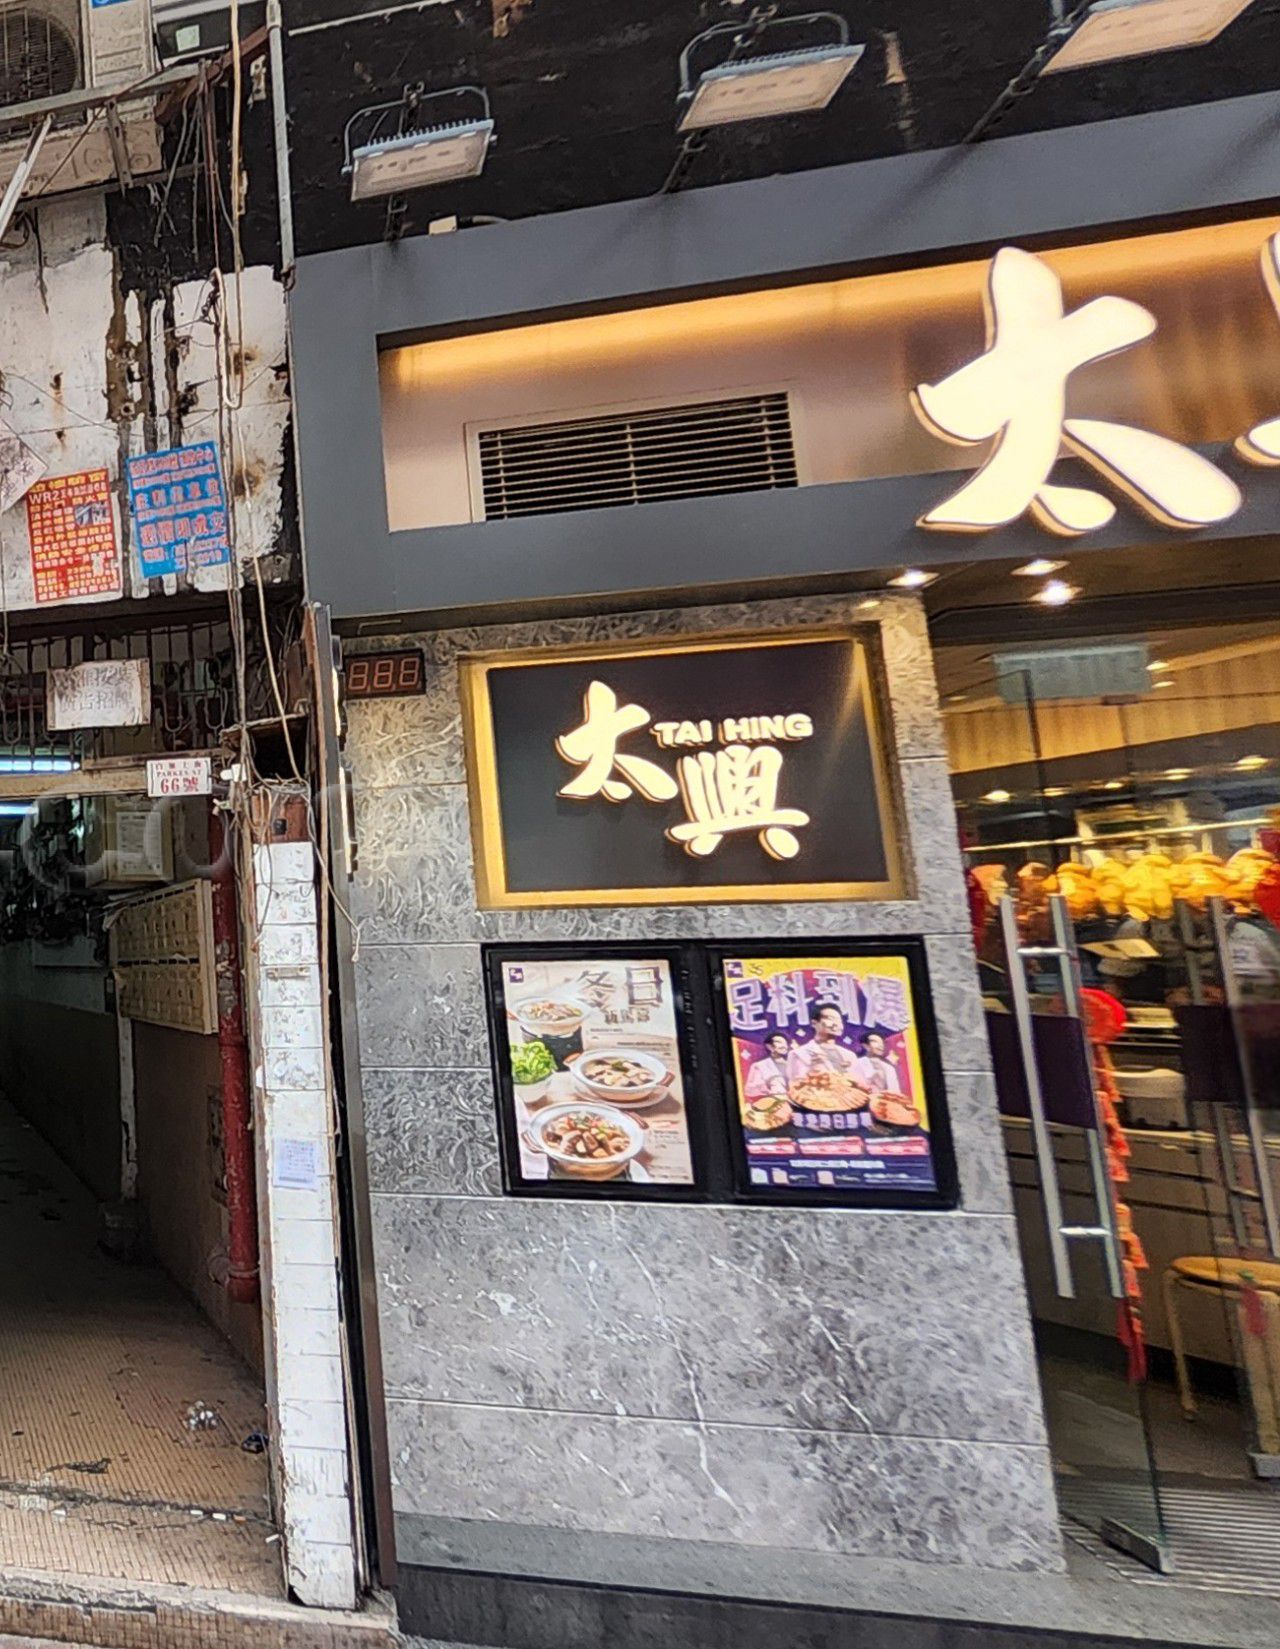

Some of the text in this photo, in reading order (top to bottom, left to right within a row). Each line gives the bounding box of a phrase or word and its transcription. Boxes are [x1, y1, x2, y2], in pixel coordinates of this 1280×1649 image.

[651, 713, 814, 747] TAI HING
[555, 679, 810, 861] 太興
[728, 969, 911, 1032] 足料到爆
